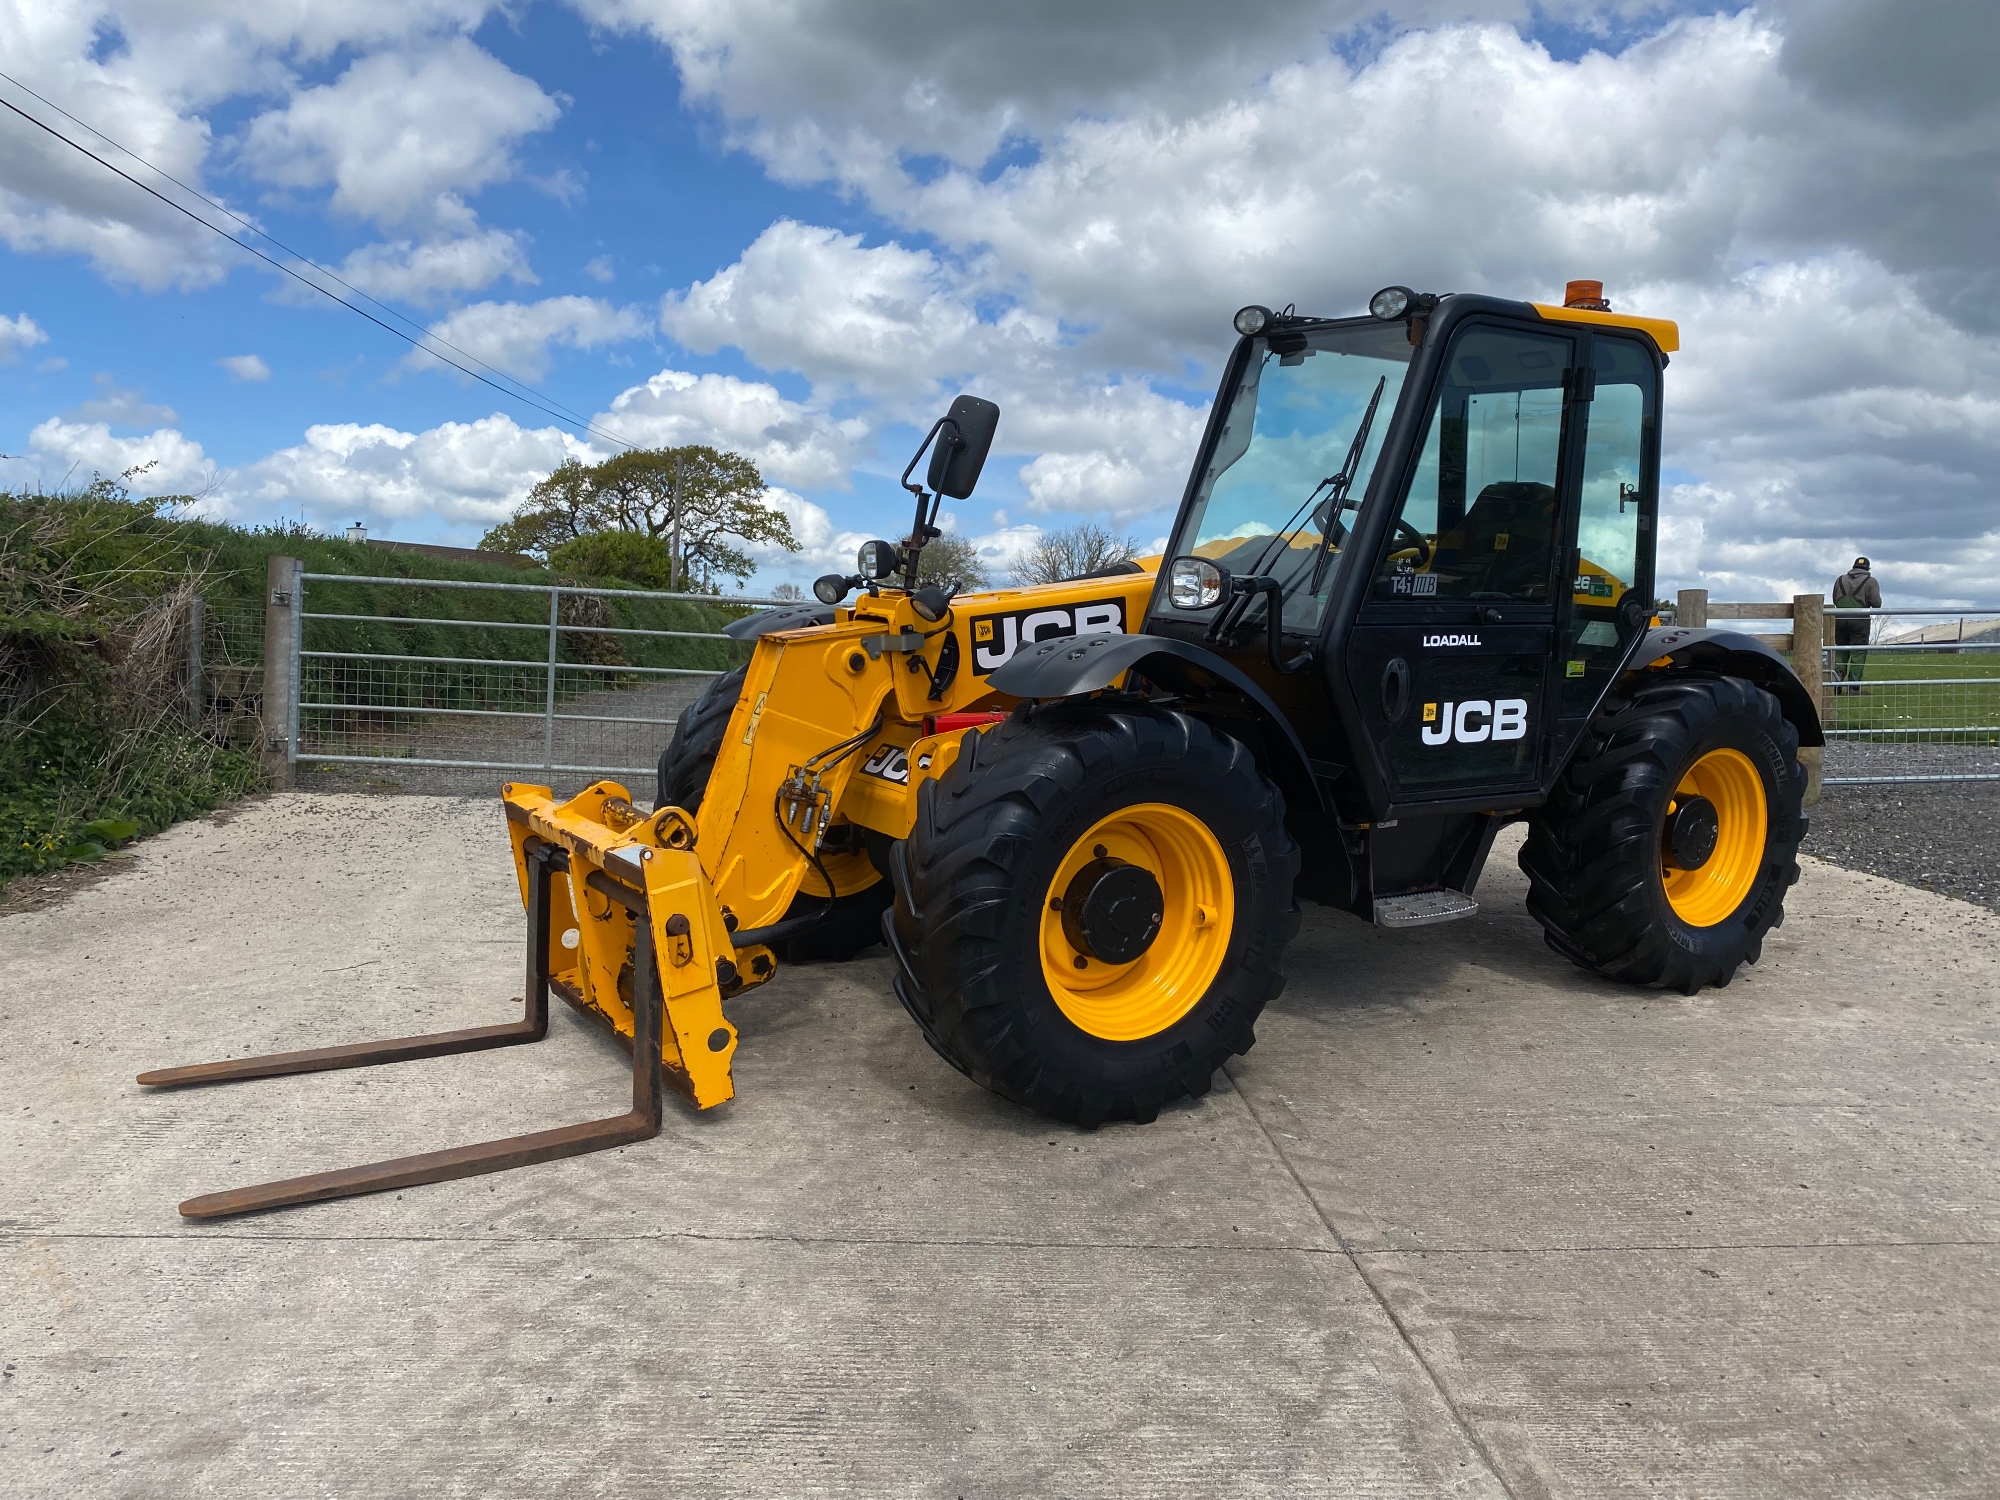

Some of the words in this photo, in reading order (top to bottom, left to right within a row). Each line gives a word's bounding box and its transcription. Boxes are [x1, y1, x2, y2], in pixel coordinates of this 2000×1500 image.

[1391, 576, 1411, 594] T4i
[976, 603, 1123, 669] JCB
[1423, 634, 1482, 647] LOADALL
[1421, 698, 1528, 746] JCB
